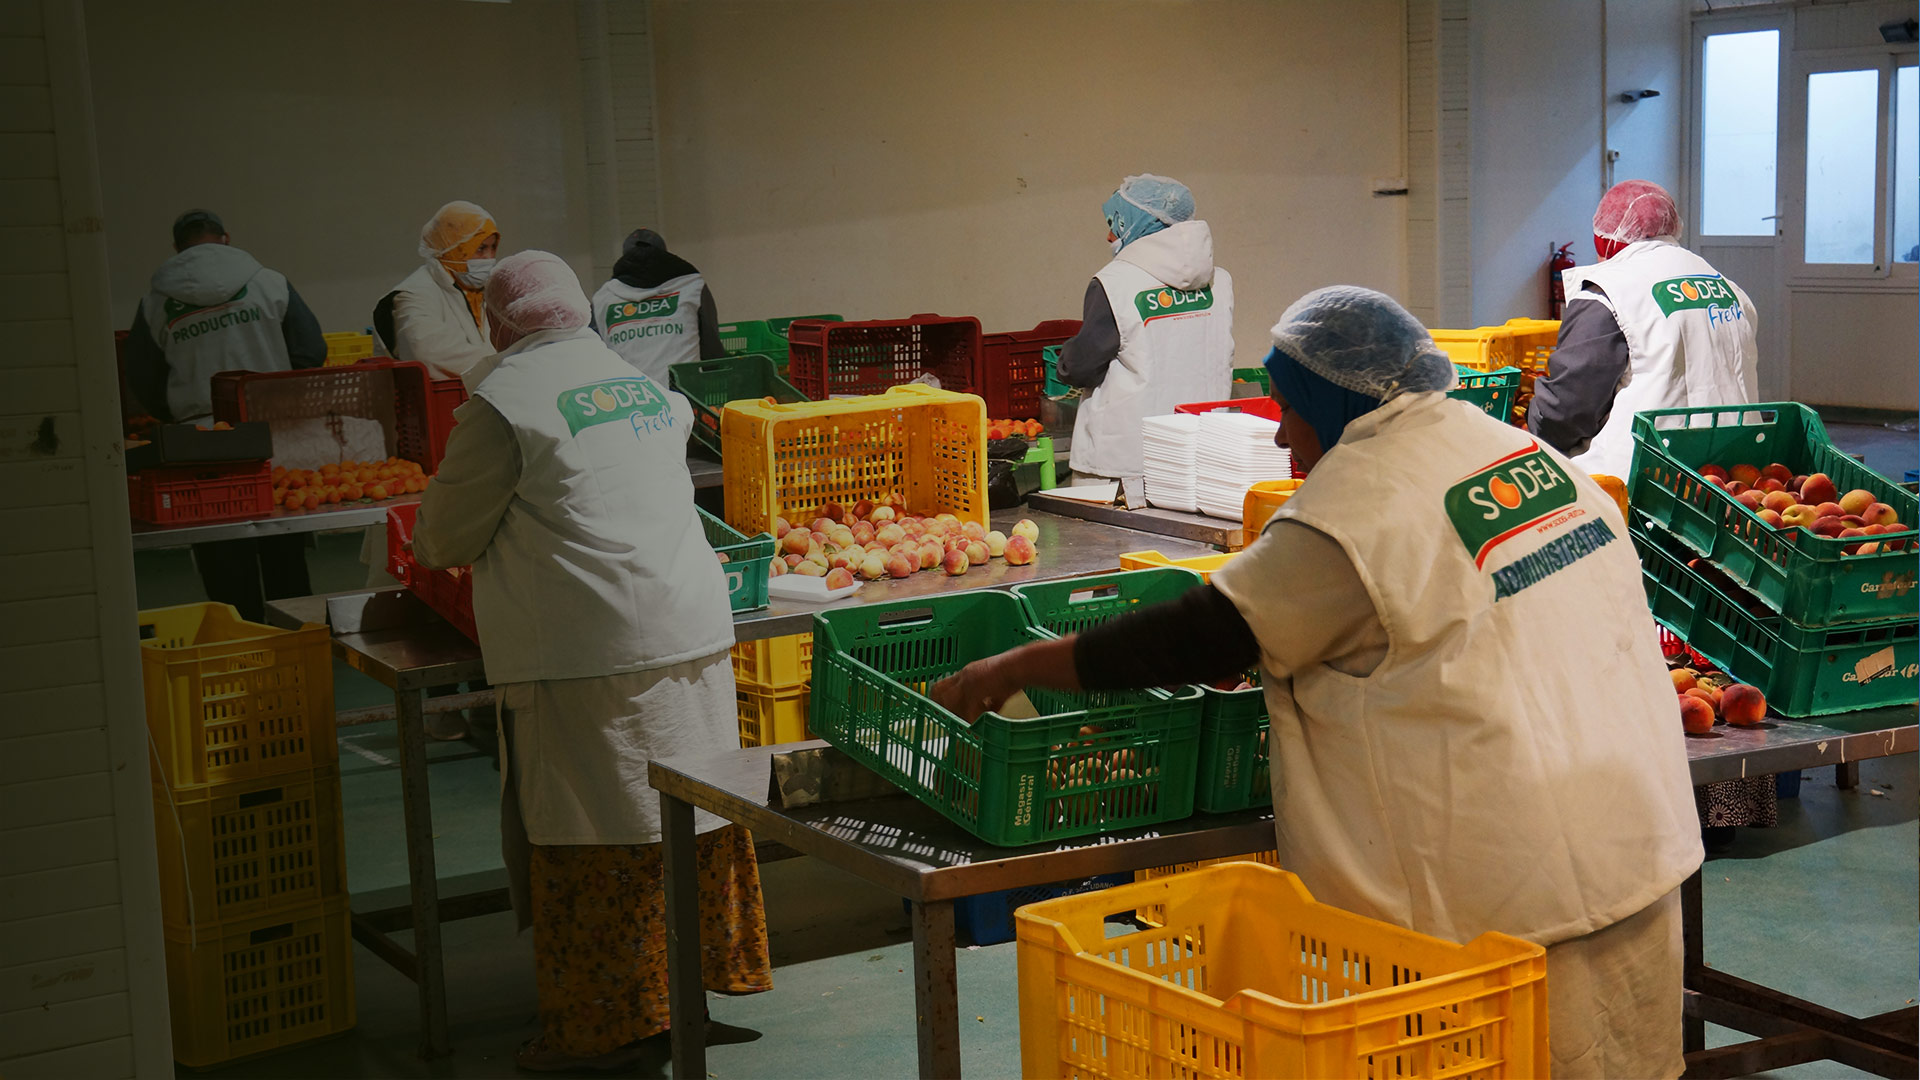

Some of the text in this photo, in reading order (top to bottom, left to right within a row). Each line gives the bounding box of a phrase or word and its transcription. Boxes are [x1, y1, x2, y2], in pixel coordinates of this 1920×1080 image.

[1666, 280, 1732, 303] SODEA
[172, 307, 260, 344] PRODUCTION
[613, 299, 671, 319] SODEA
[1708, 301, 1744, 330] Fresh
[574, 384, 662, 416] SODEA
[630, 407, 677, 441] Fresh
[1468, 456, 1566, 520] SODEA
[1014, 774, 1027, 826] Magasin
